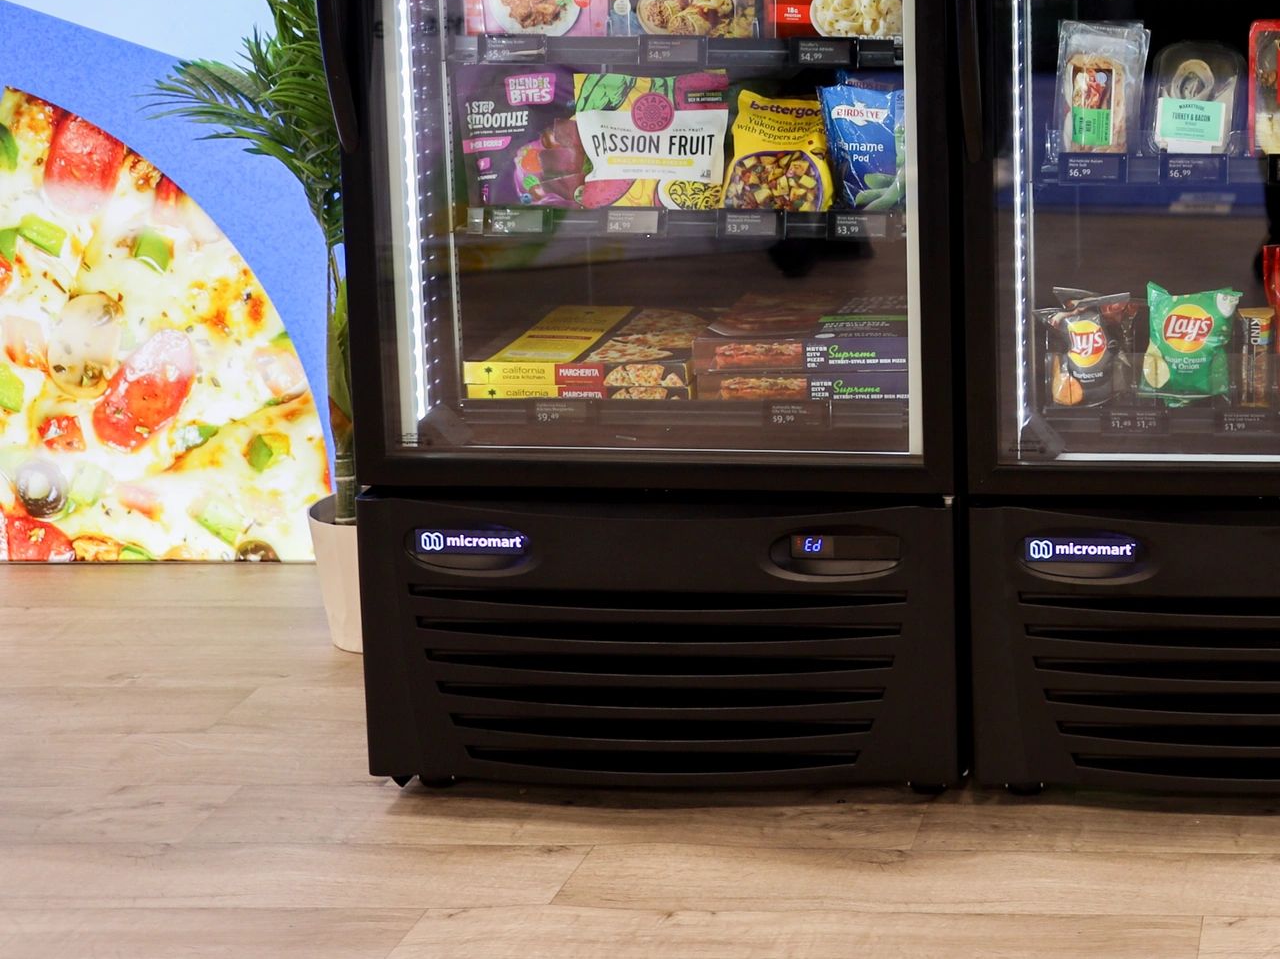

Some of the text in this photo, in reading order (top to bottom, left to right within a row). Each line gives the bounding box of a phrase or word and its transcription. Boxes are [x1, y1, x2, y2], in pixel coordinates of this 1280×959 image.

[471, 101, 495, 114] STEP
[736, 123, 791, 142] with Peppers
[748, 116, 797, 133] Yukon Gold
[592, 134, 715, 158] PASSION FRUIT
[852, 154, 869, 162] Pod
[1069, 168, 1091, 177] $6.99
[1166, 313, 1214, 341] Lay's
[1250, 318, 1260, 345] KIND
[828, 344, 877, 361] Supreme
[833, 380, 881, 395] Supreme
[803, 538, 822, 553] Ed
